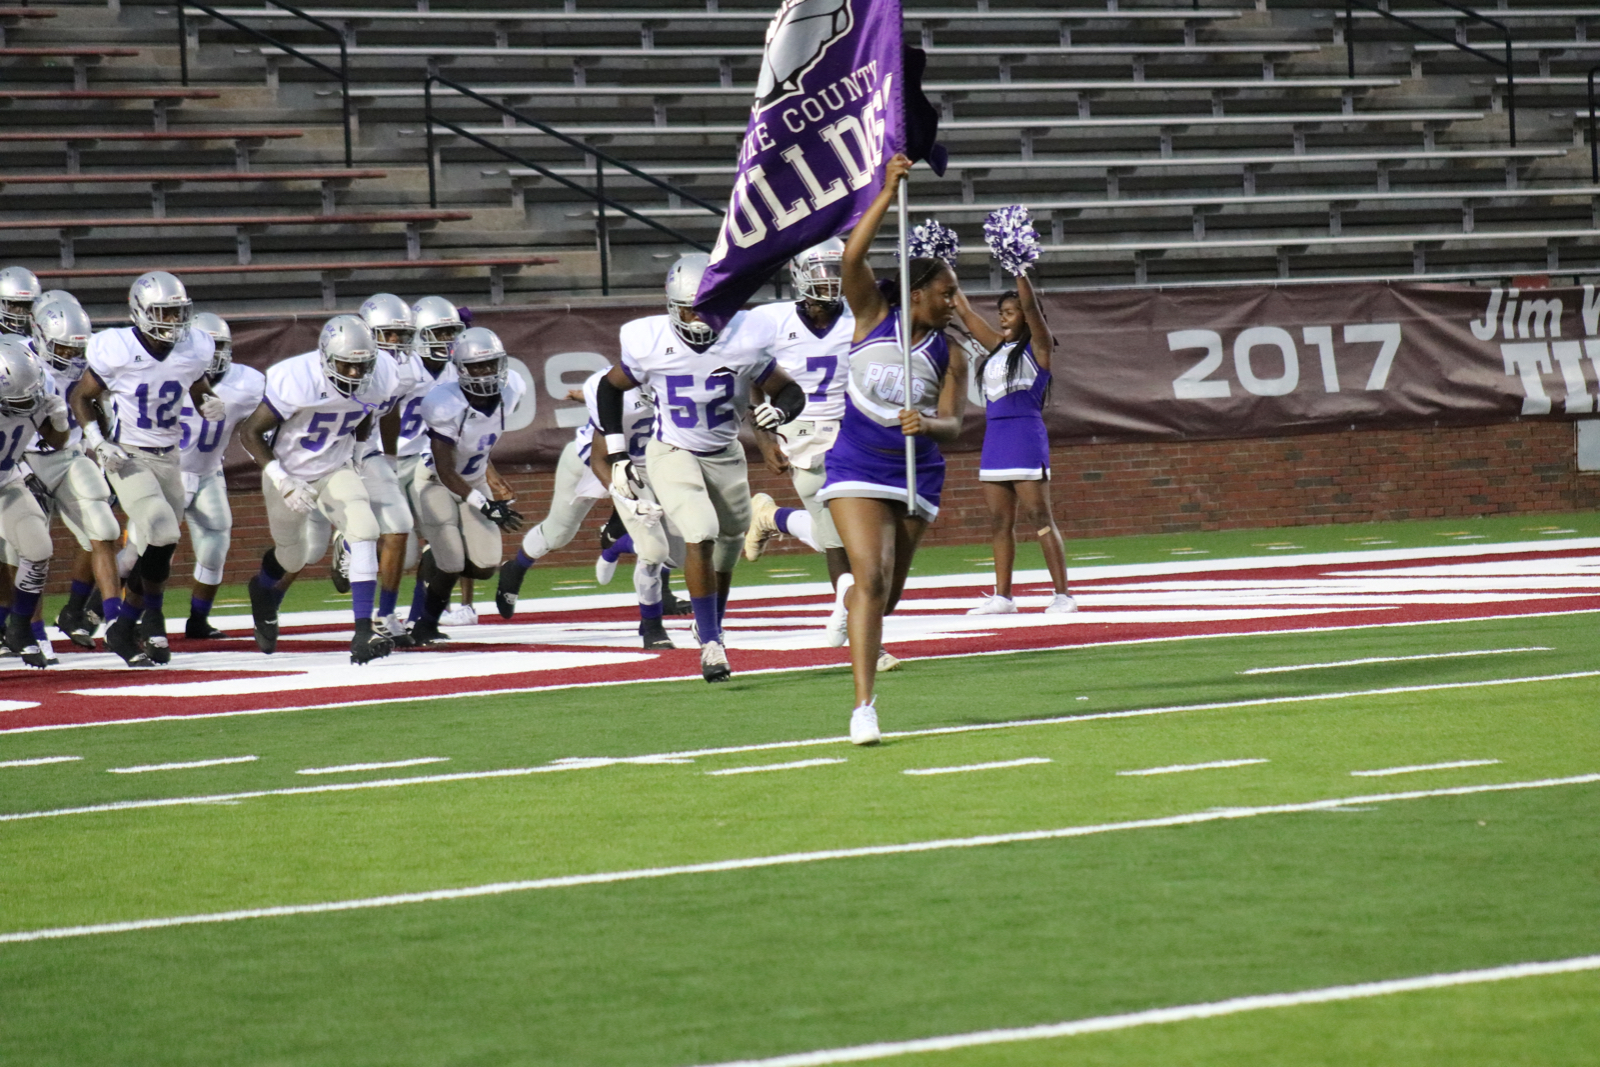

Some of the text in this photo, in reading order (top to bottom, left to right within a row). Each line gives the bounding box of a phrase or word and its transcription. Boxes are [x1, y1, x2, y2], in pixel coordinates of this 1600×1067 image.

[738, 60, 877, 171] IKE COUNTY
[708, 73, 893, 266] ULLDOG
[1470, 288, 1563, 341] Jim
[806, 355, 838, 402] 7
[863, 362, 925, 404] PCHS
[1167, 323, 1402, 399] 2017
[135, 381, 183, 429] 12
[665, 373, 735, 430] 52
[0, 424, 24, 471] 1
